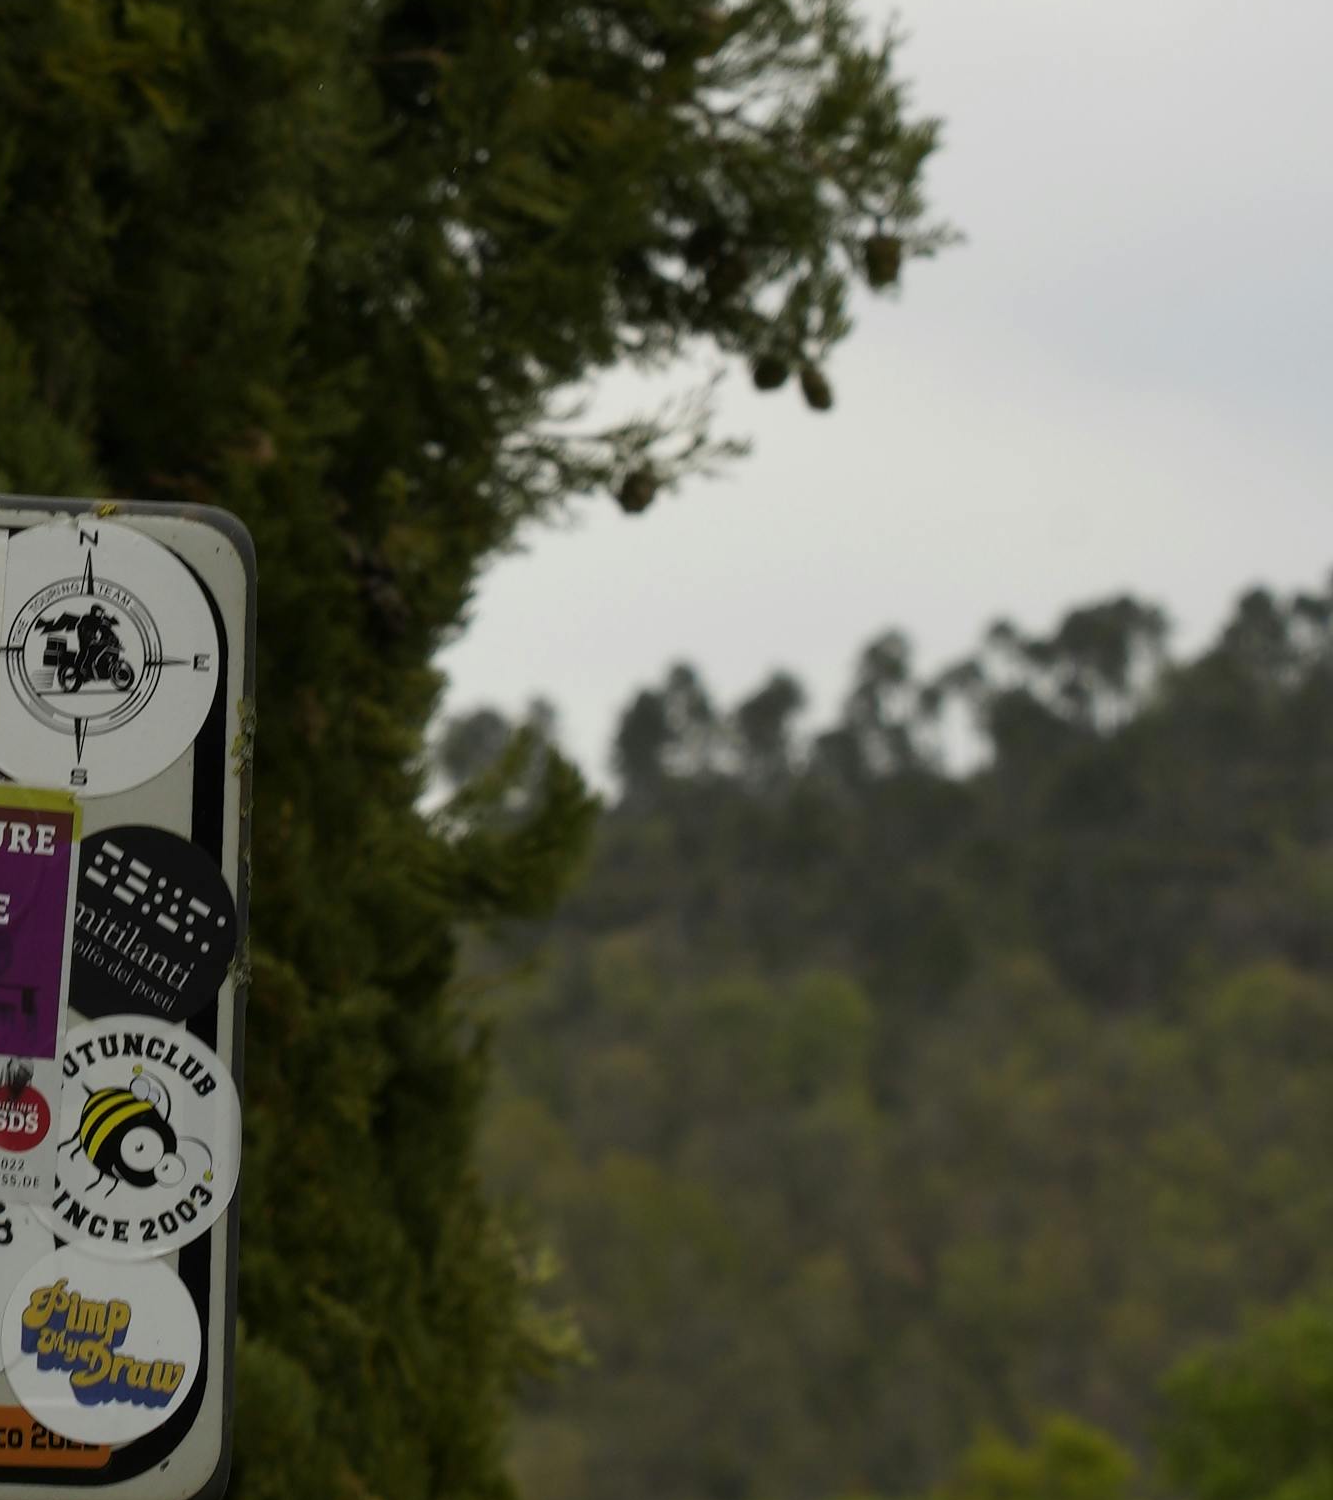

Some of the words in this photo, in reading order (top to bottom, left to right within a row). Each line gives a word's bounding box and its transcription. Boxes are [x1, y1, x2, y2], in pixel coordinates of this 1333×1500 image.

[98, 584, 133, 607] TEAM
[105, 958, 130, 985] dei
[138, 1182, 214, 1243] 2003
[22, 1278, 132, 1339] Pimp
[70, 1340, 185, 1392] Draw
